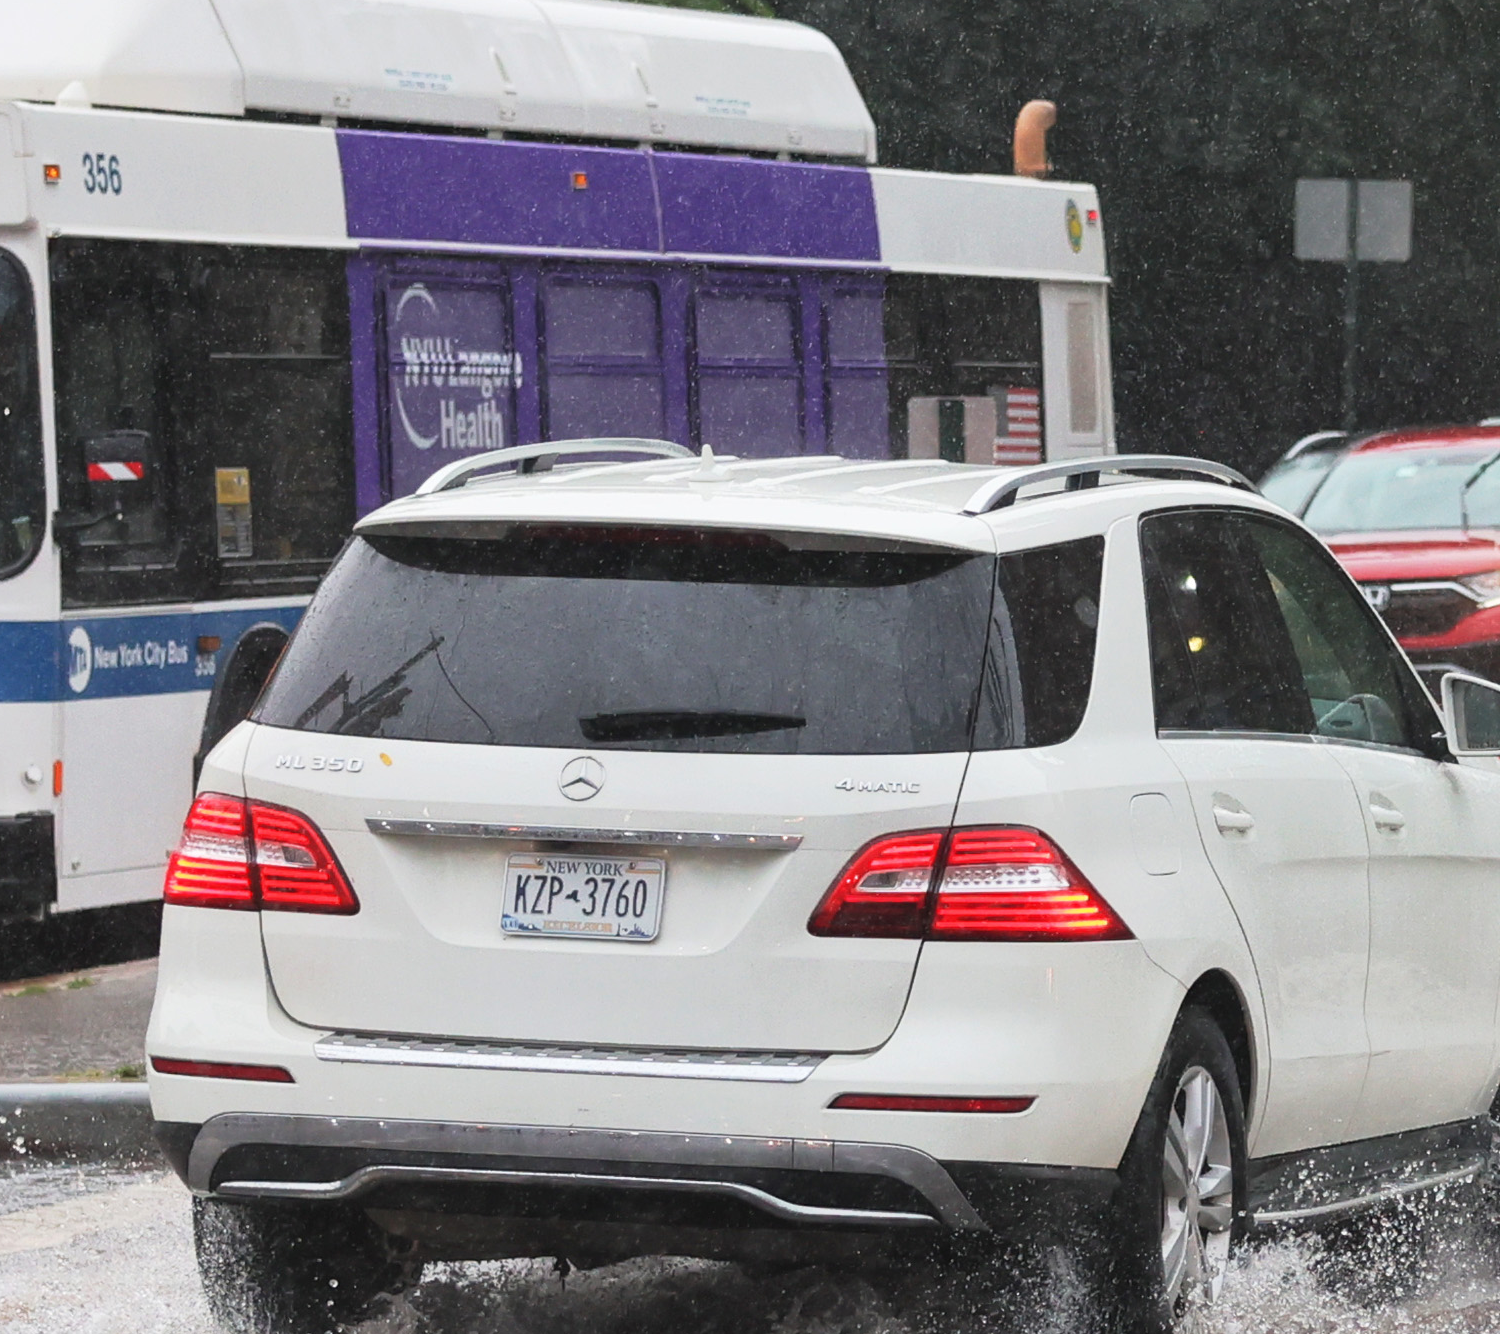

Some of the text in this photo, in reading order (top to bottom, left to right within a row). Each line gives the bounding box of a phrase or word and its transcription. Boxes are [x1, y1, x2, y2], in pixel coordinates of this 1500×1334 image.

[82, 152, 122, 196] 356
[440, 399, 505, 450] Health
[94, 645, 118, 669] New
[120, 642, 143, 667] York
[144, 640, 167, 669] City
[168, 639, 189, 665] Bus
[275, 754, 365, 774] ML 350
[834, 776, 921, 794] 4MATIC
[545, 860, 625, 877] NEW YORK
